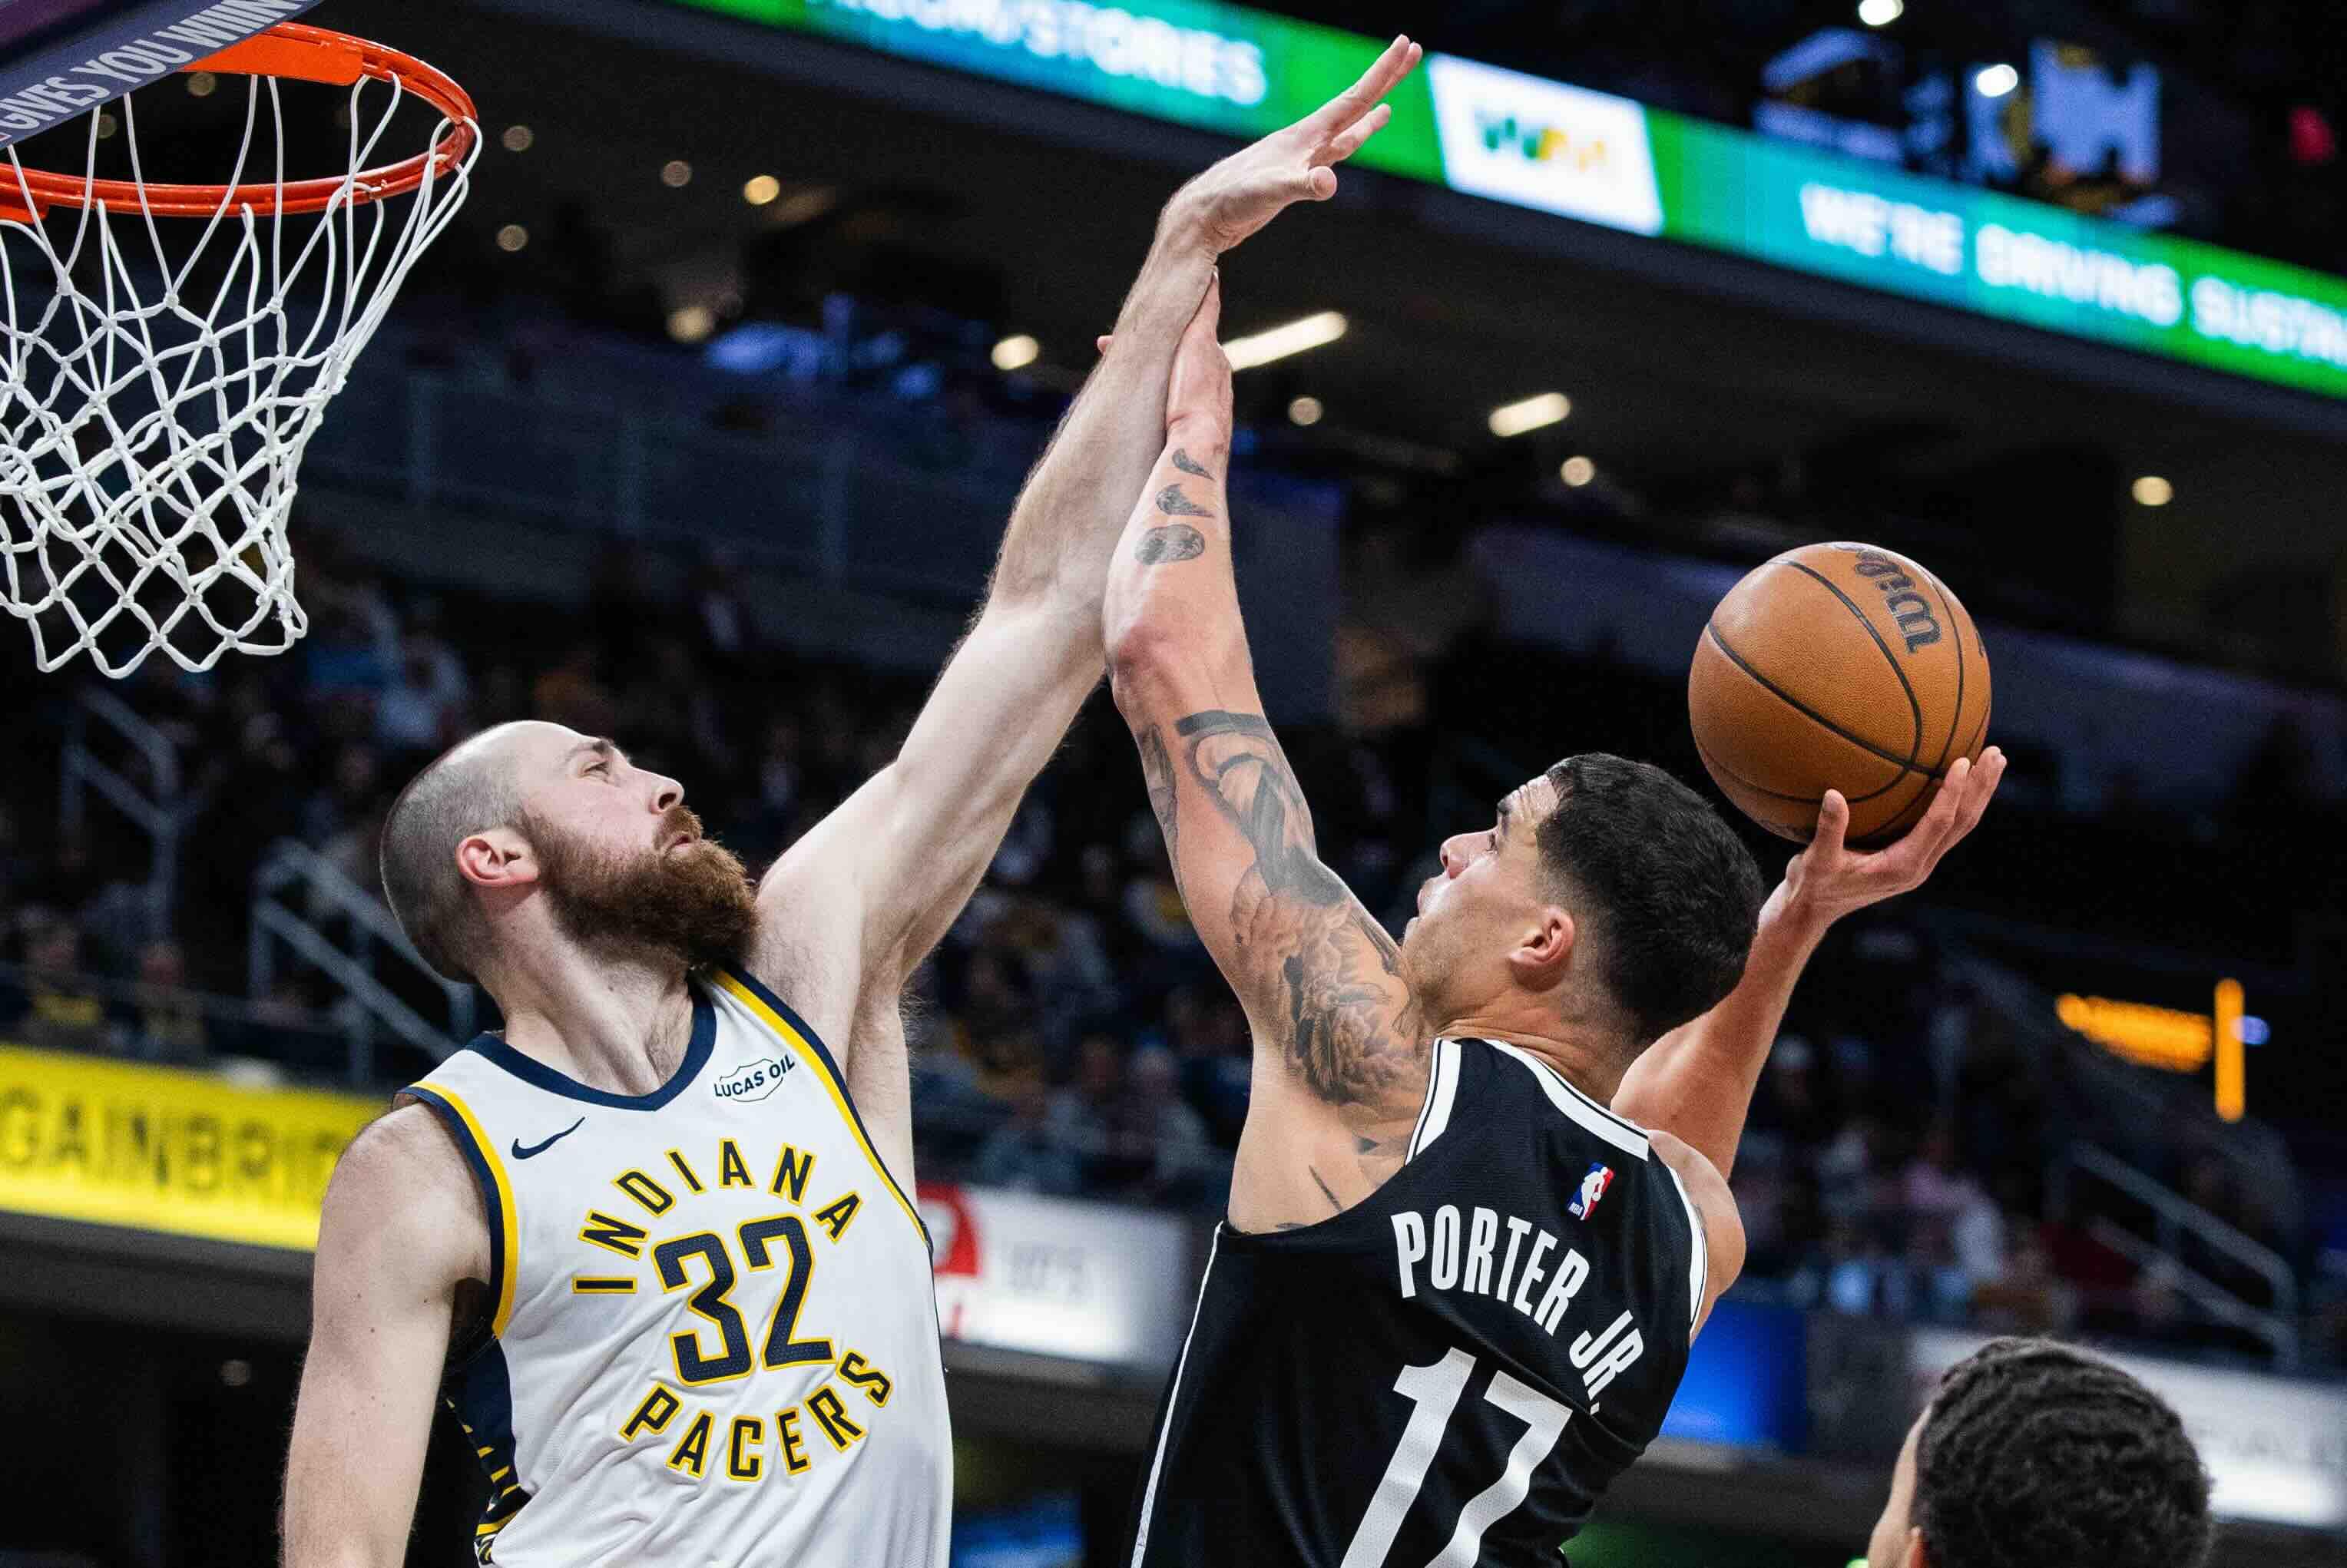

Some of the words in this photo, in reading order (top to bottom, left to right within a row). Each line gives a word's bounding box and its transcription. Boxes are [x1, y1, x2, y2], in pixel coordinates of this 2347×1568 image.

[0, 77, 111, 129] GIVES
[71, 39, 194, 83] YOU
[1799, 183, 1964, 275] WE'RE
[713, 1070, 764, 1097] LUCAS
[769, 1054, 795, 1079] OIL
[572, 1137, 863, 1294] INDIANA
[1391, 1204, 1589, 1337] PORTER
[1567, 1202, 1584, 1217] NBA
[651, 1214, 836, 1387] 32
[619, 1351, 894, 1481] PACERS
[1340, 1347, 1573, 1568] 17
